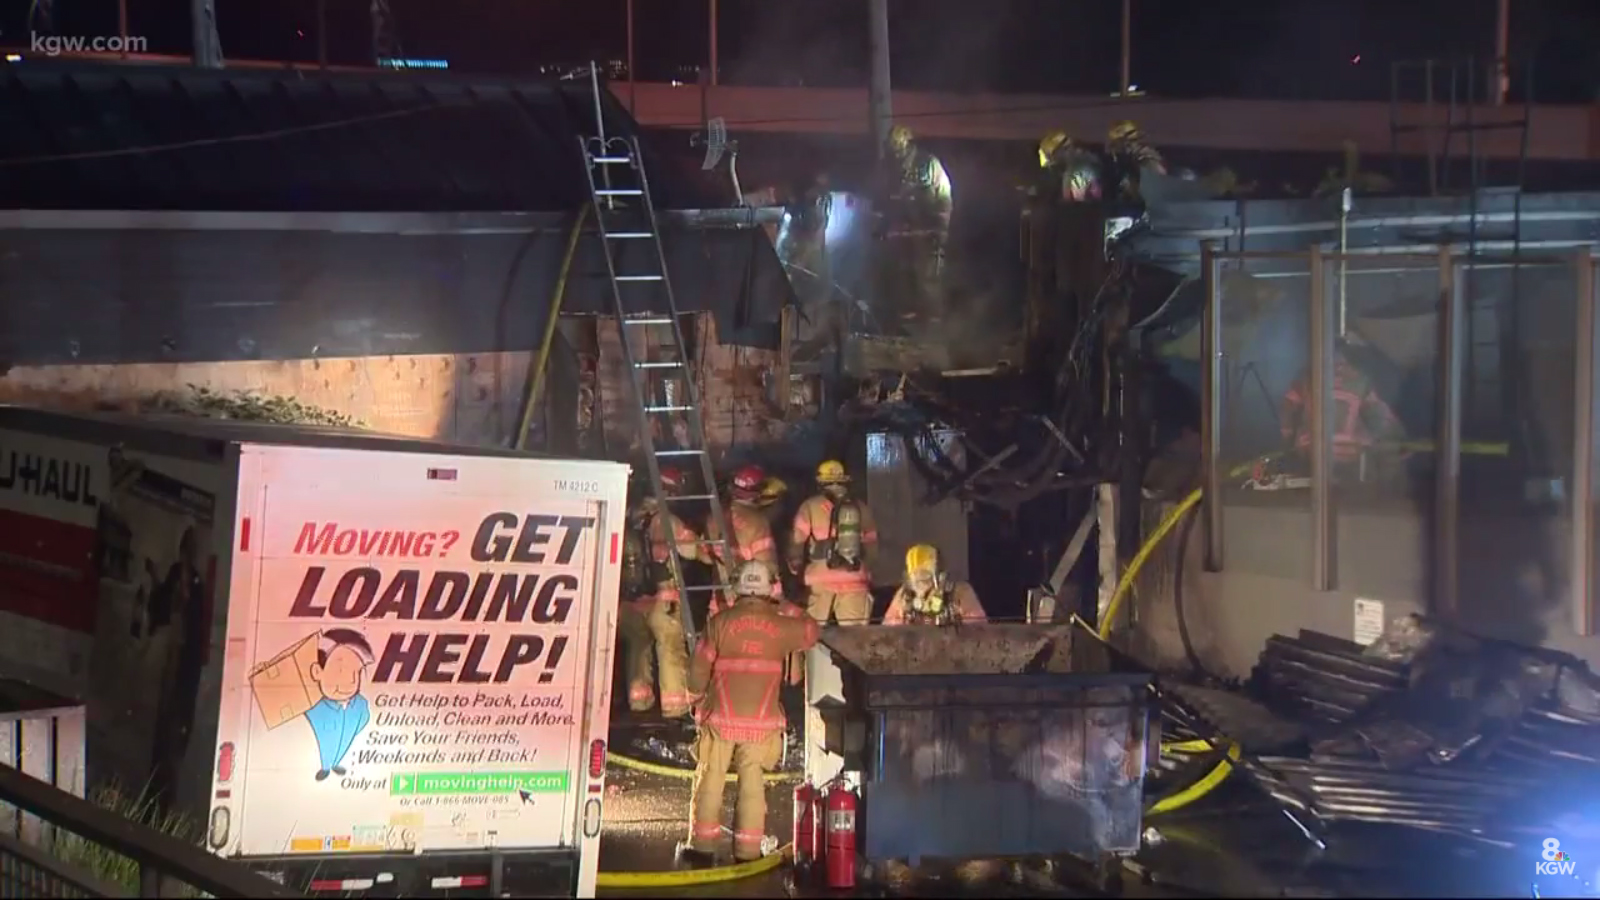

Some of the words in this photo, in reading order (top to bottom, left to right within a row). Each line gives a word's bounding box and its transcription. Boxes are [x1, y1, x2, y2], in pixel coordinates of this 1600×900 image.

[293, 522, 460, 558] MOVING?
[470, 511, 595, 565] GET
[288, 566, 579, 625] LOADING
[371, 632, 569, 684] HELP!
[375, 693, 406, 708] Get
[409, 693, 449, 710] Help
[453, 694, 469, 708] to
[472, 692, 516, 709] Pack,
[520, 693, 564, 709] Load,
[376, 711, 439, 728] Unload,
[443, 711, 491, 726] Clean
[495, 711, 528, 726] and
[366, 730, 409, 746] Save
[413, 730, 449, 746] Your
[454, 730, 520, 747] Friends,
[358, 749, 446, 764] Weekends
[450, 749, 485, 764] and
[487, 749, 537, 763] Back!
[341, 777, 371, 790] Only
[373, 778, 387, 790] at
[424, 775, 561, 791] movinghelp.com
